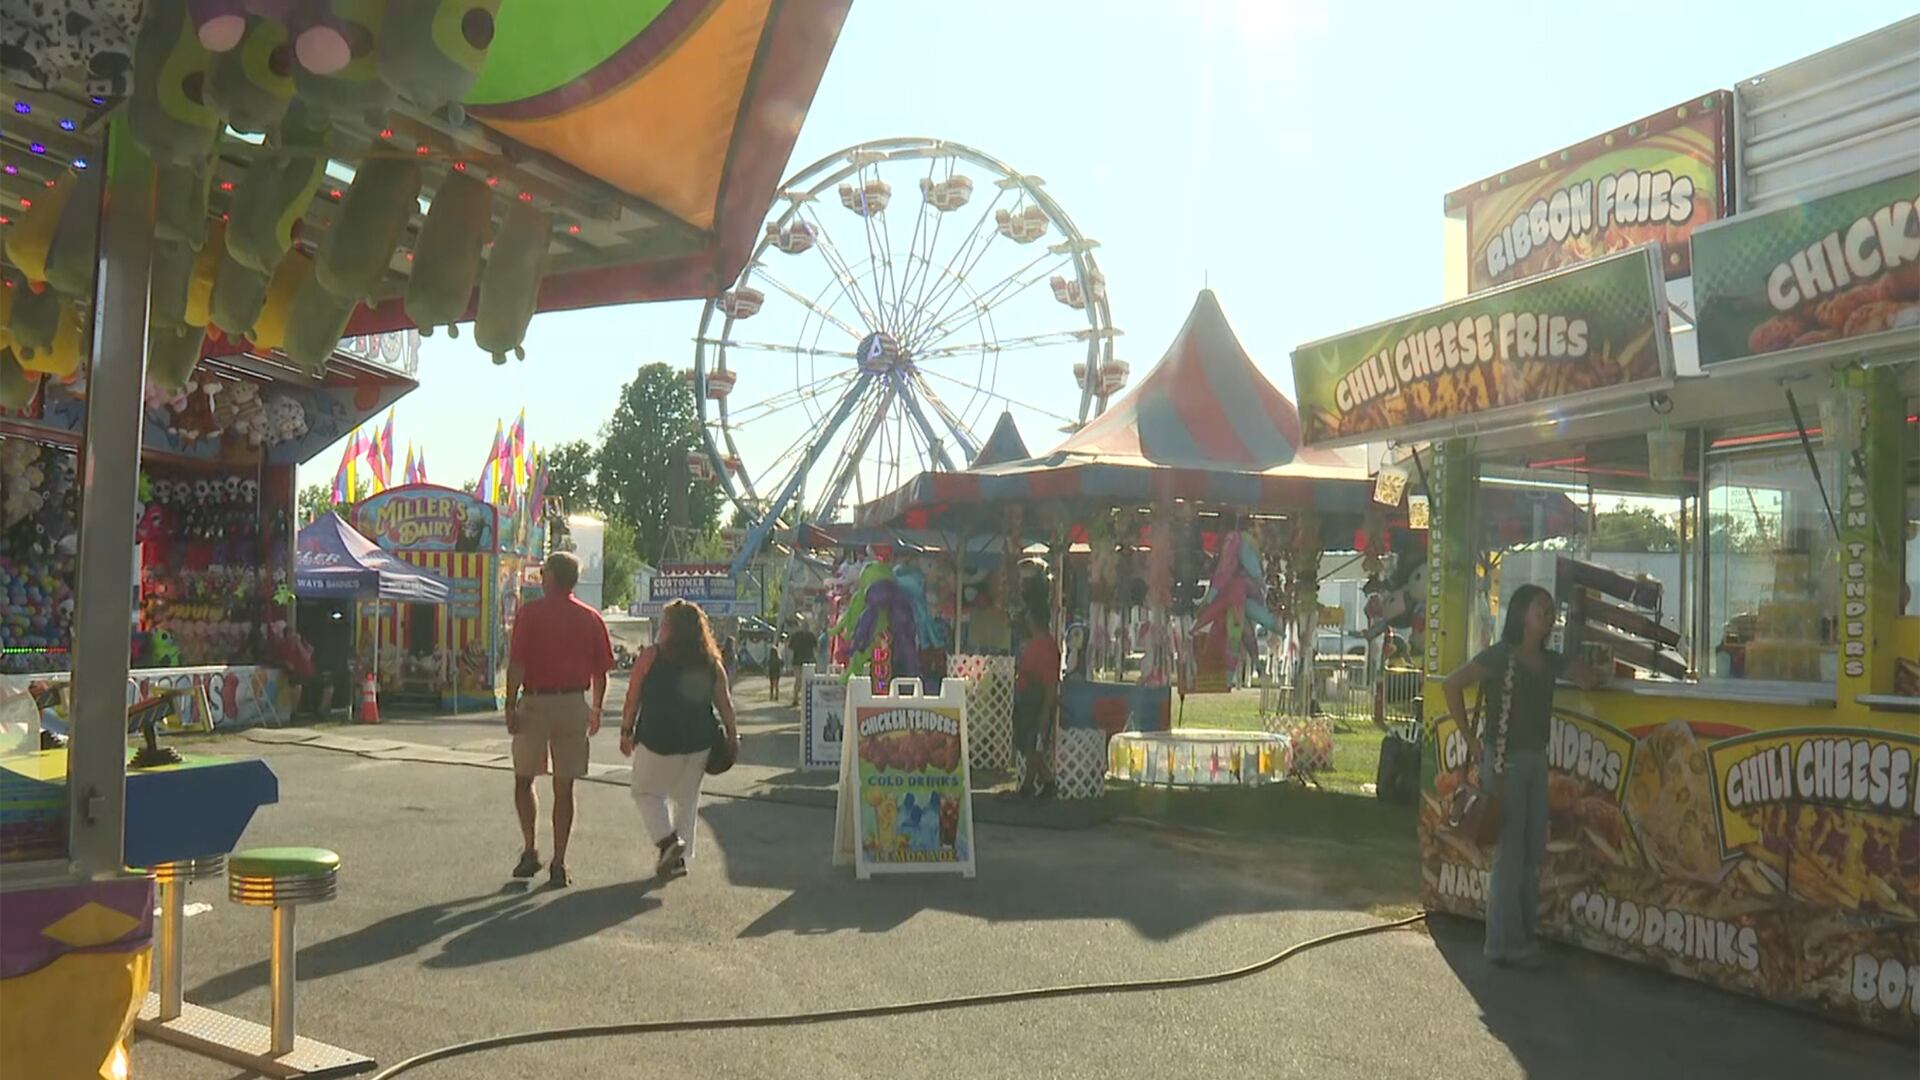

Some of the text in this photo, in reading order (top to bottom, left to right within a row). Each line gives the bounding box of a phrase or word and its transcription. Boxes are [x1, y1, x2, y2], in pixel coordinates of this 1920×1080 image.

[1486, 169, 1695, 277] RIBBON FRIES
[1767, 193, 1920, 311] CHICK
[1336, 311, 1589, 412] CHILI CHEESE FRIES
[375, 498, 468, 534] MILLER'S
[400, 520, 456, 547] DAIRY
[653, 578, 705, 588] CUSTOMER
[653, 588, 705, 598] ASSISTANCE
[1845, 543, 1867, 677] TENDERS
[1429, 604, 1440, 671] FRIES
[860, 709, 958, 737] CHICKEN TENDERS
[1547, 715, 1622, 792] NDERS
[868, 775, 959, 787] COLD DRINKS
[1726, 743, 1792, 808] CHILI
[1796, 738, 1912, 810] CHEESE
[874, 849, 957, 863] LEMONADE
[1570, 889, 1761, 972] COLD DRINKS
